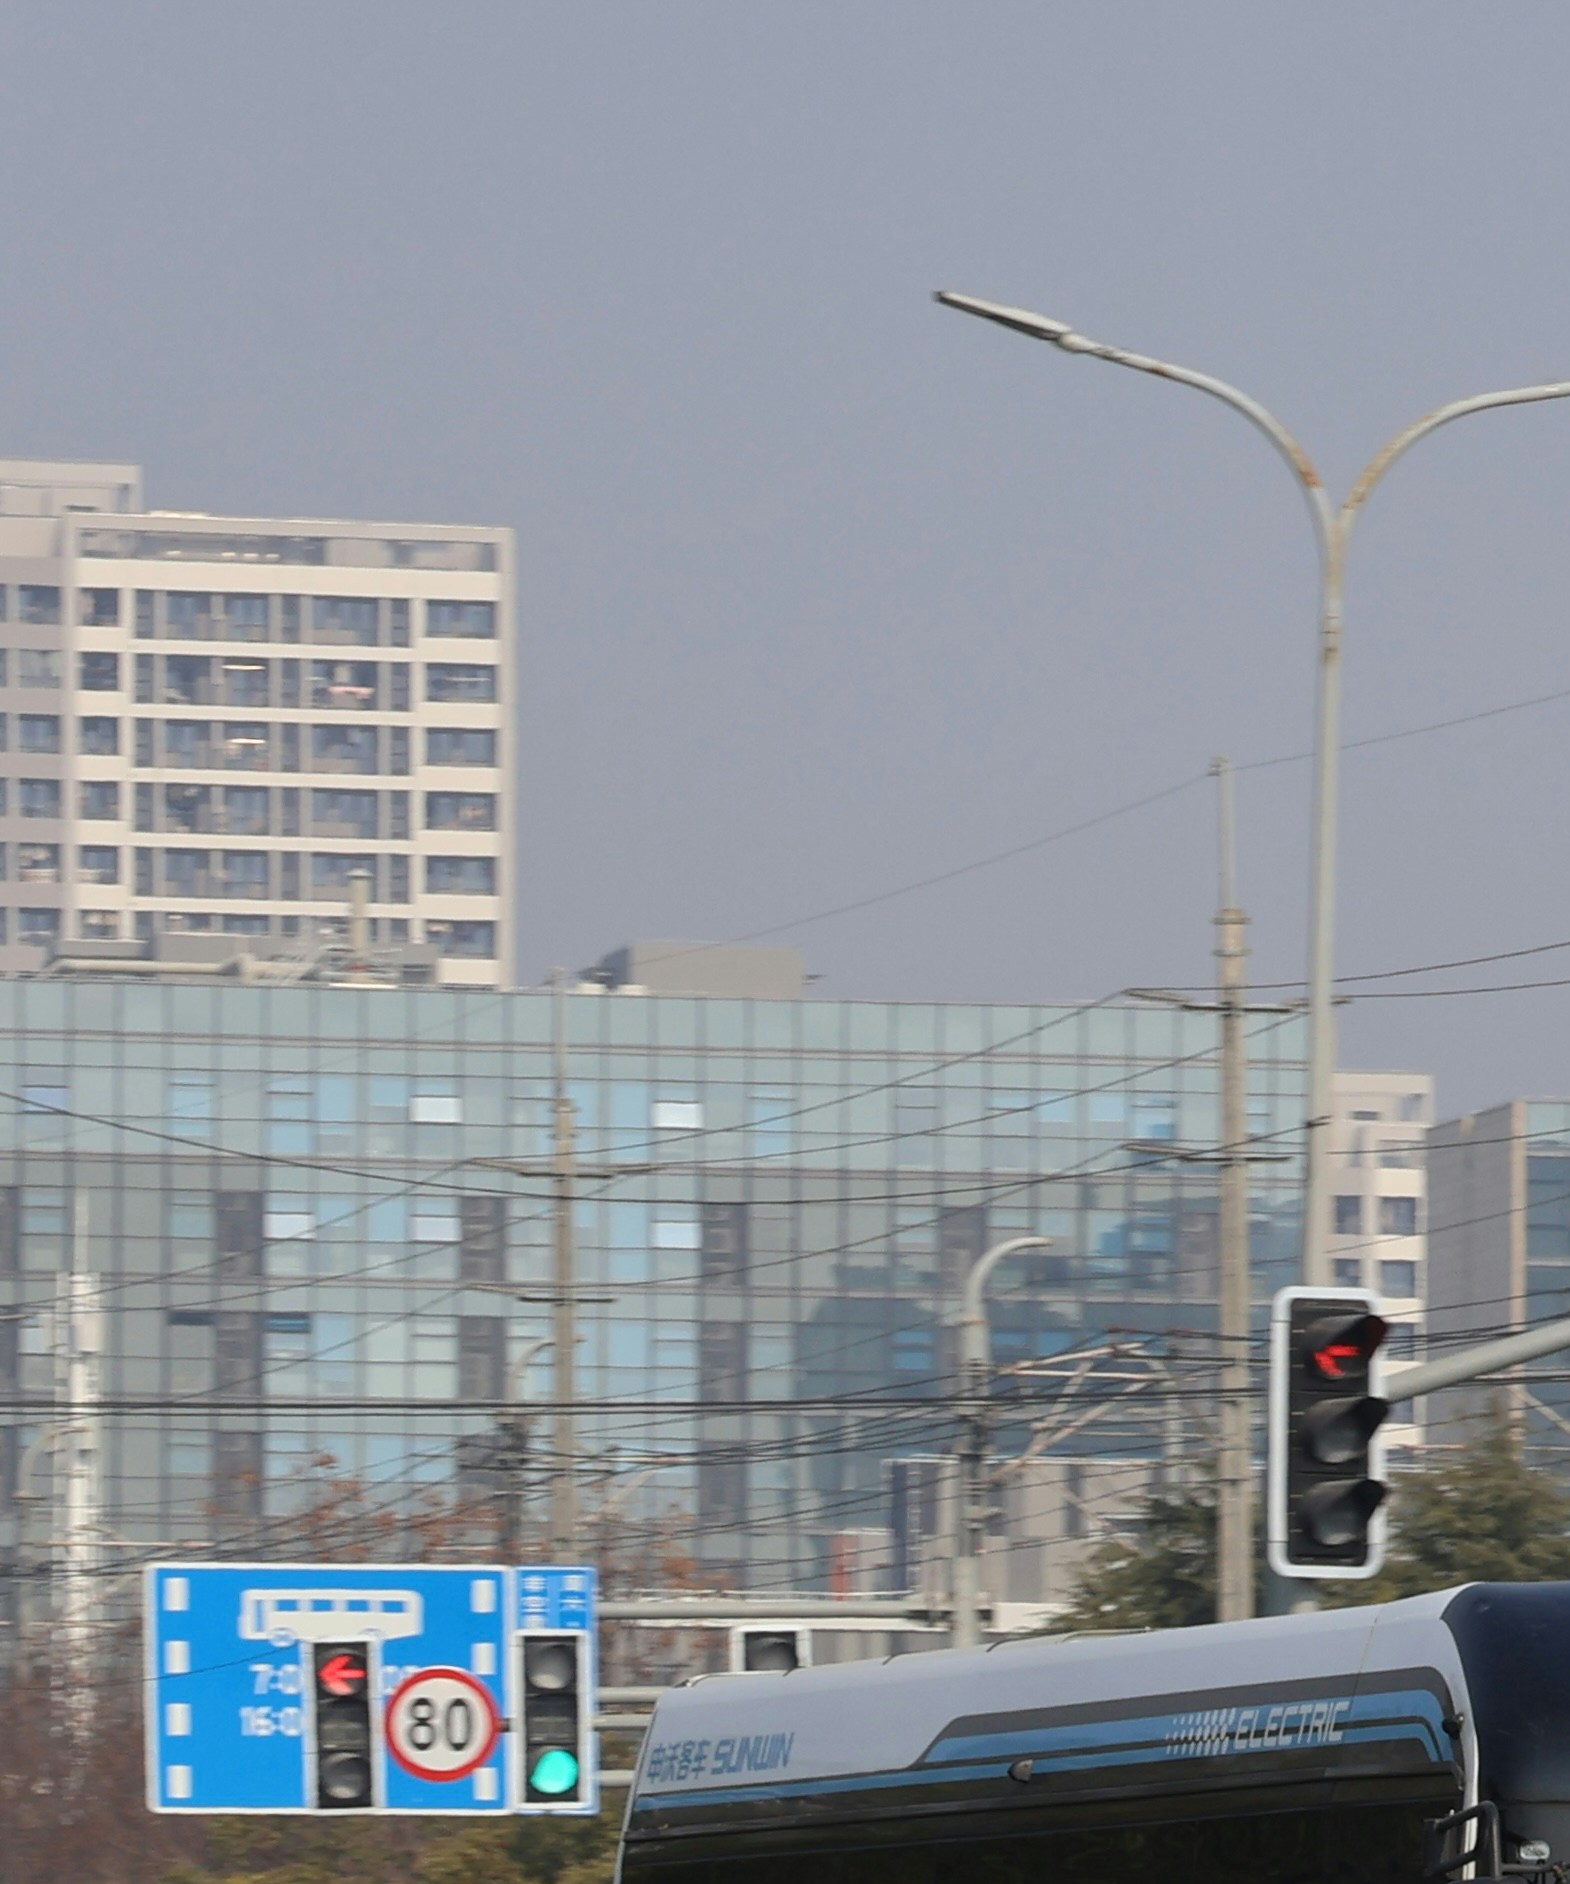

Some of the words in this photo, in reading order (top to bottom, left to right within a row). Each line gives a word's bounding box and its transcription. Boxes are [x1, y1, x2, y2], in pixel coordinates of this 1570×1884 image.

[409, 1697, 473, 1751] 80
[1235, 1701, 1350, 1750] ELECTRIC
[647, 1739, 711, 1783] 申沃客车
[711, 1732, 795, 1775] SUNWIN
